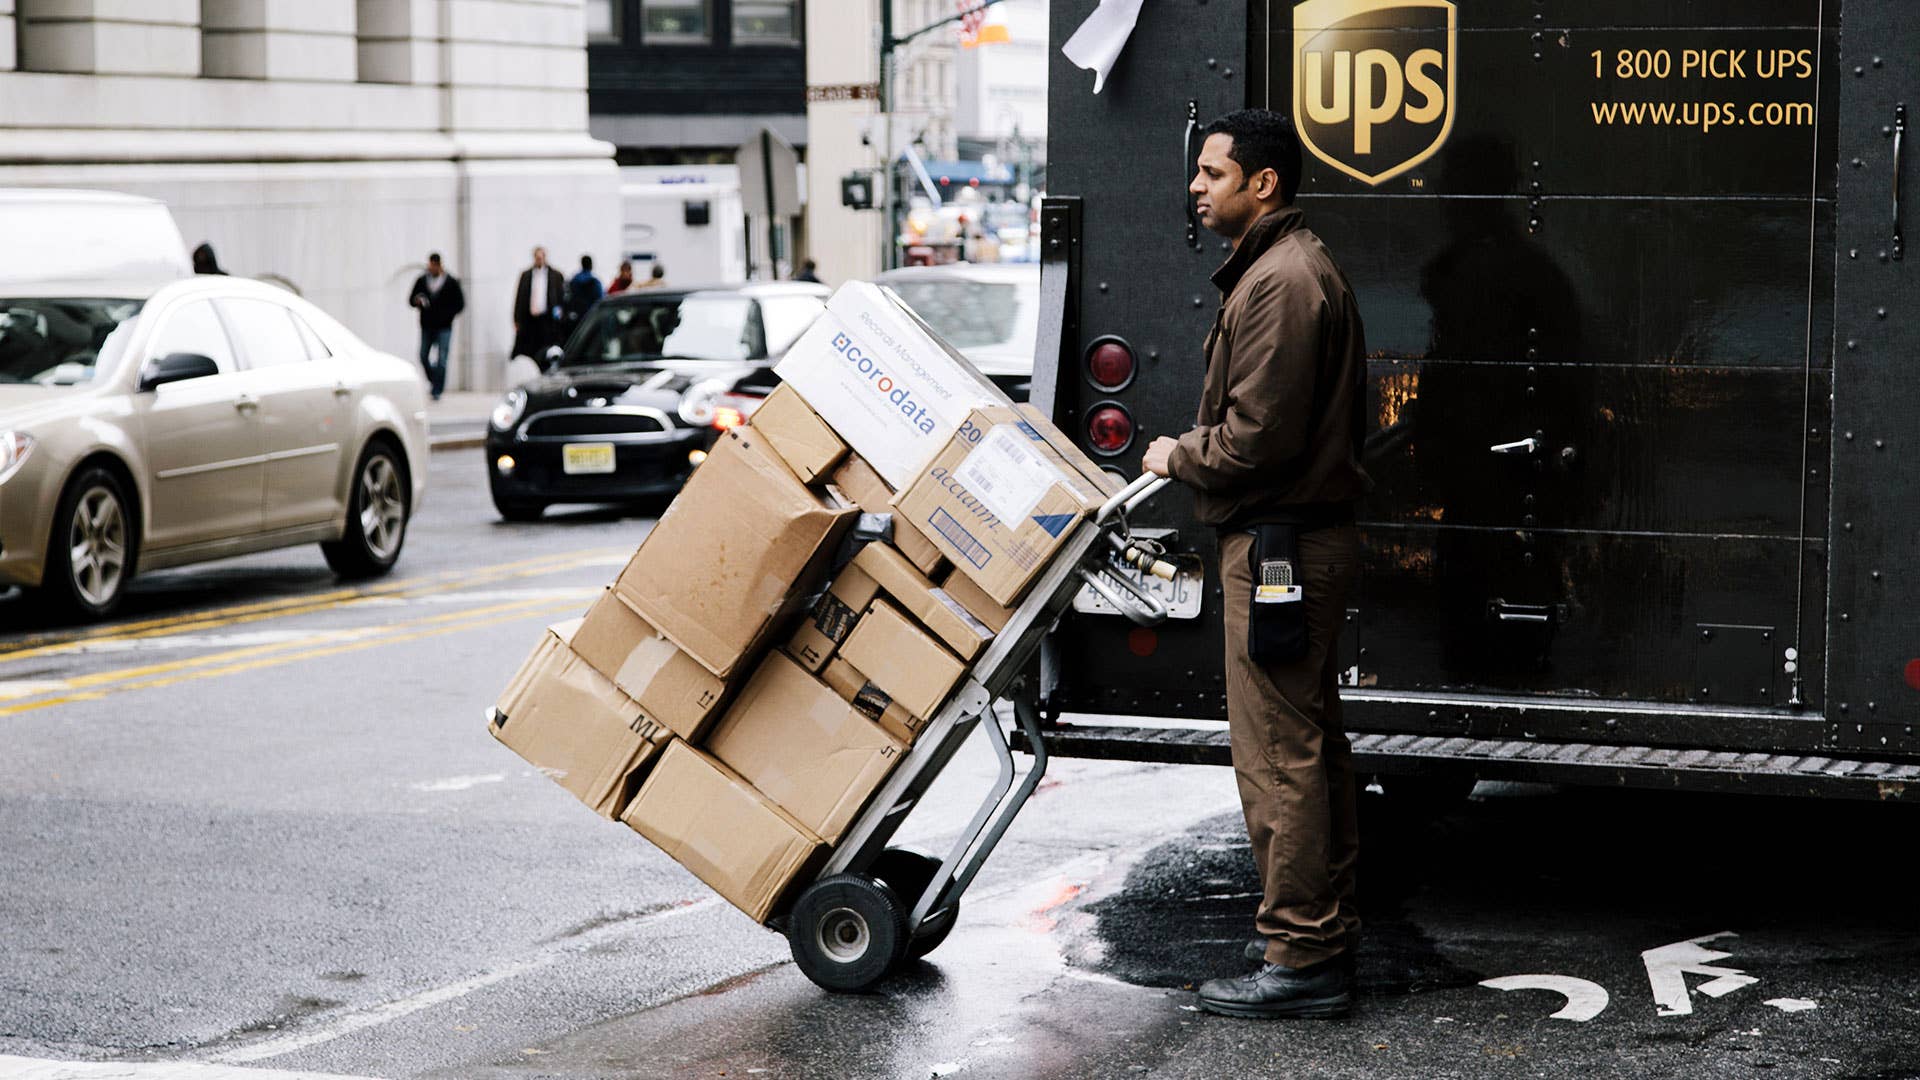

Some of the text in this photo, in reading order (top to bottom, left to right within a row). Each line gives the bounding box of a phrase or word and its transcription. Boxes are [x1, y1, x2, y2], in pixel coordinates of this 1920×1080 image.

[1591, 48, 1812, 79] 1 800 PICK UPS
[1305, 48, 1445, 155] ups
[1591, 102, 1814, 134] www.ups.com
[846, 346, 936, 436] corodata
[958, 419, 984, 445] 20
